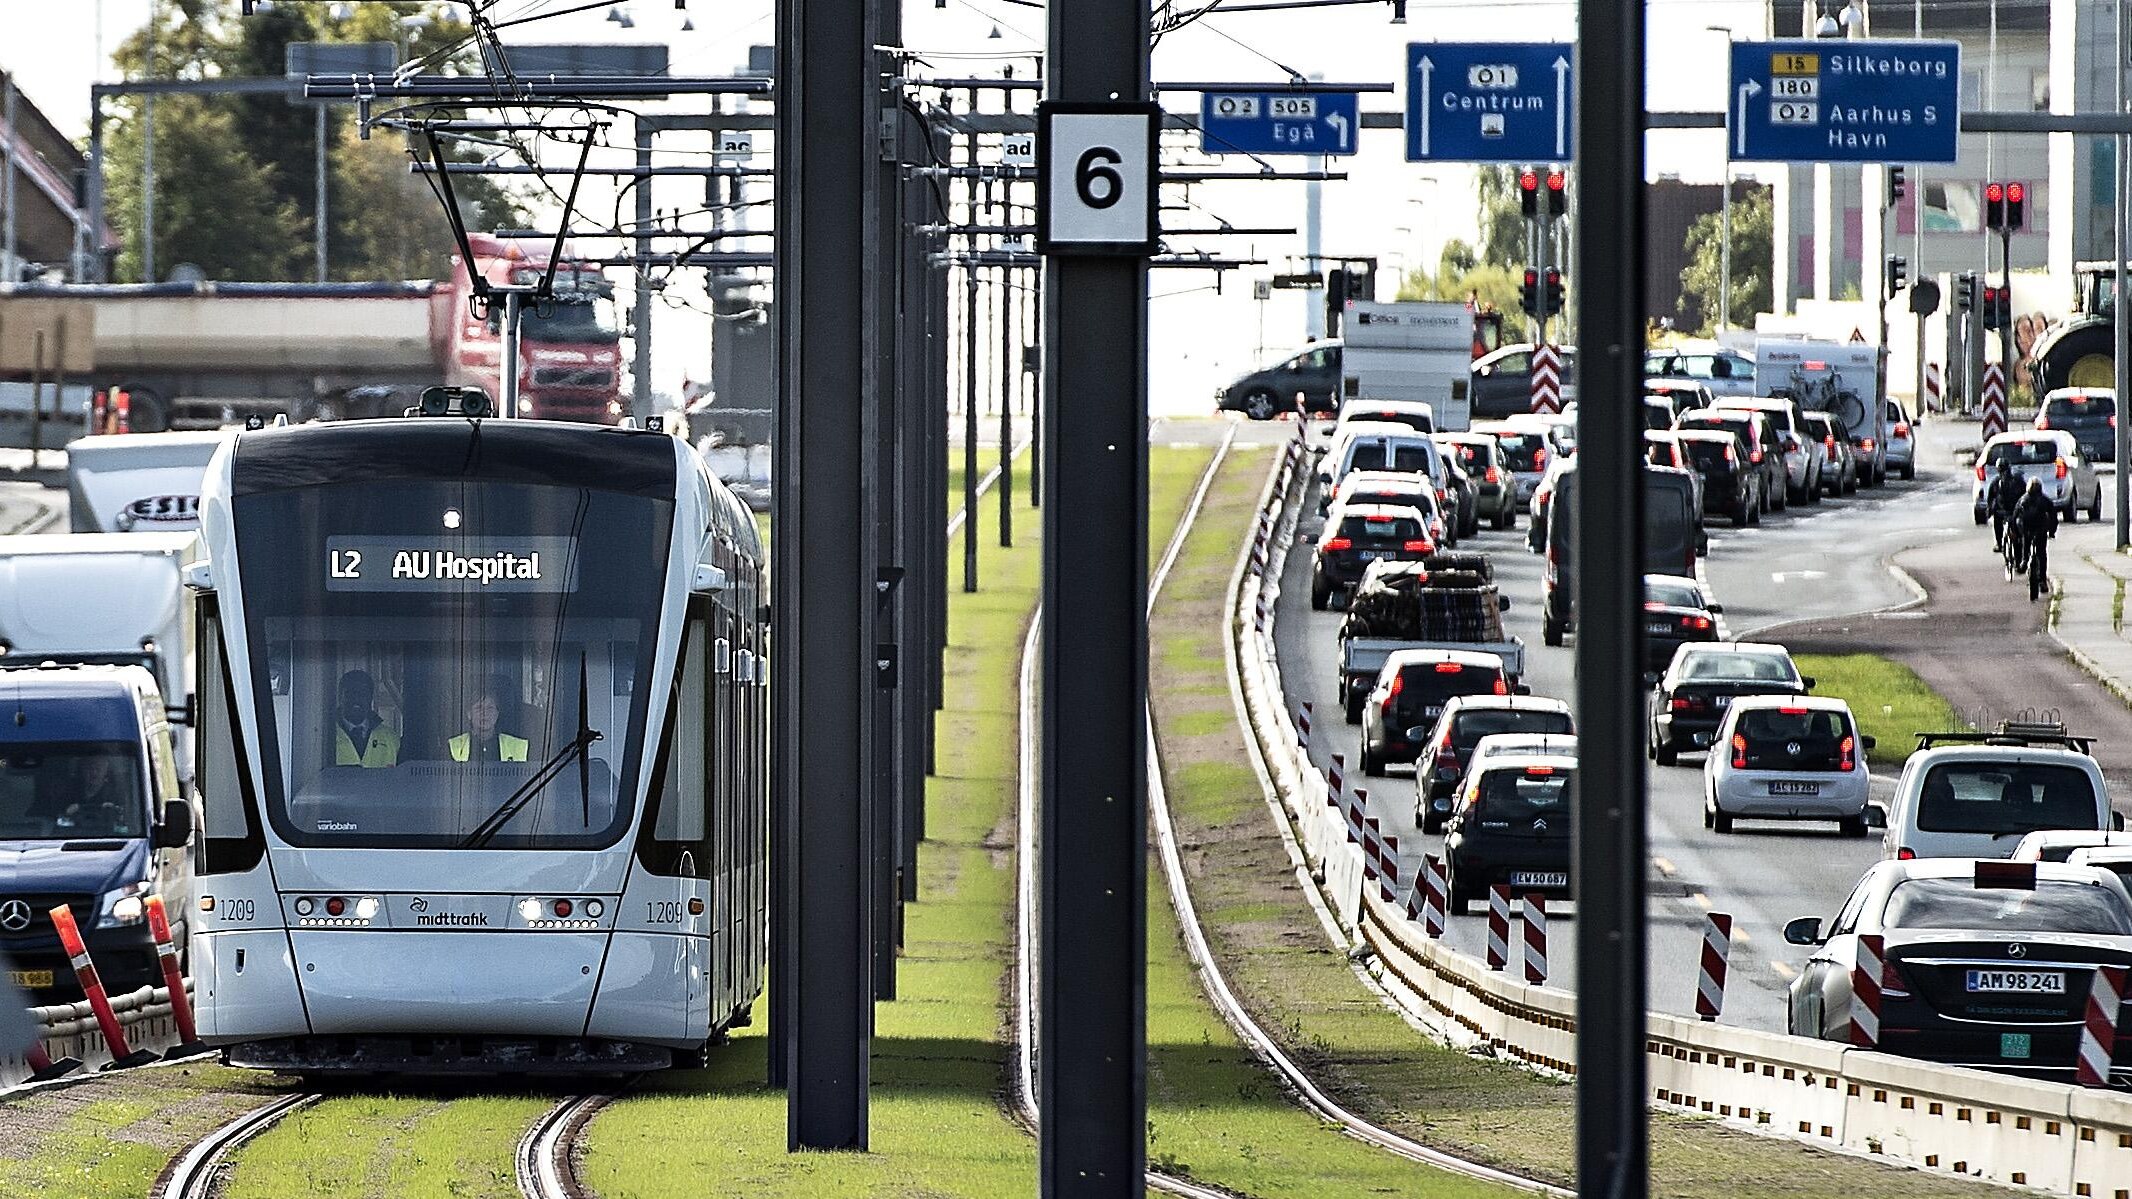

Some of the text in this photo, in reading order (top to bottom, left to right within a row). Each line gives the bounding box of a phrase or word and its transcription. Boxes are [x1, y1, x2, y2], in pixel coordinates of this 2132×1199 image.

[1786, 56, 1805, 71] 15
[1830, 55, 1947, 79] Silkeborg
[1779, 80, 1812, 95] 180
[1275, 99, 1311, 114] 505
[1442, 91, 1543, 111] Centrum
[1829, 104, 1938, 126] Aarhus S
[1006, 141, 1031, 156] ad
[1828, 128, 1887, 149] Havn
[1075, 146, 1124, 210] 6
[331, 550, 541, 585] L2 AU Hospital
[220, 899, 255, 921] 1209
[417, 911, 488, 926] midttrafik
[646, 901, 683, 924] 1209
[1979, 973, 2062, 990] AM 98 241
